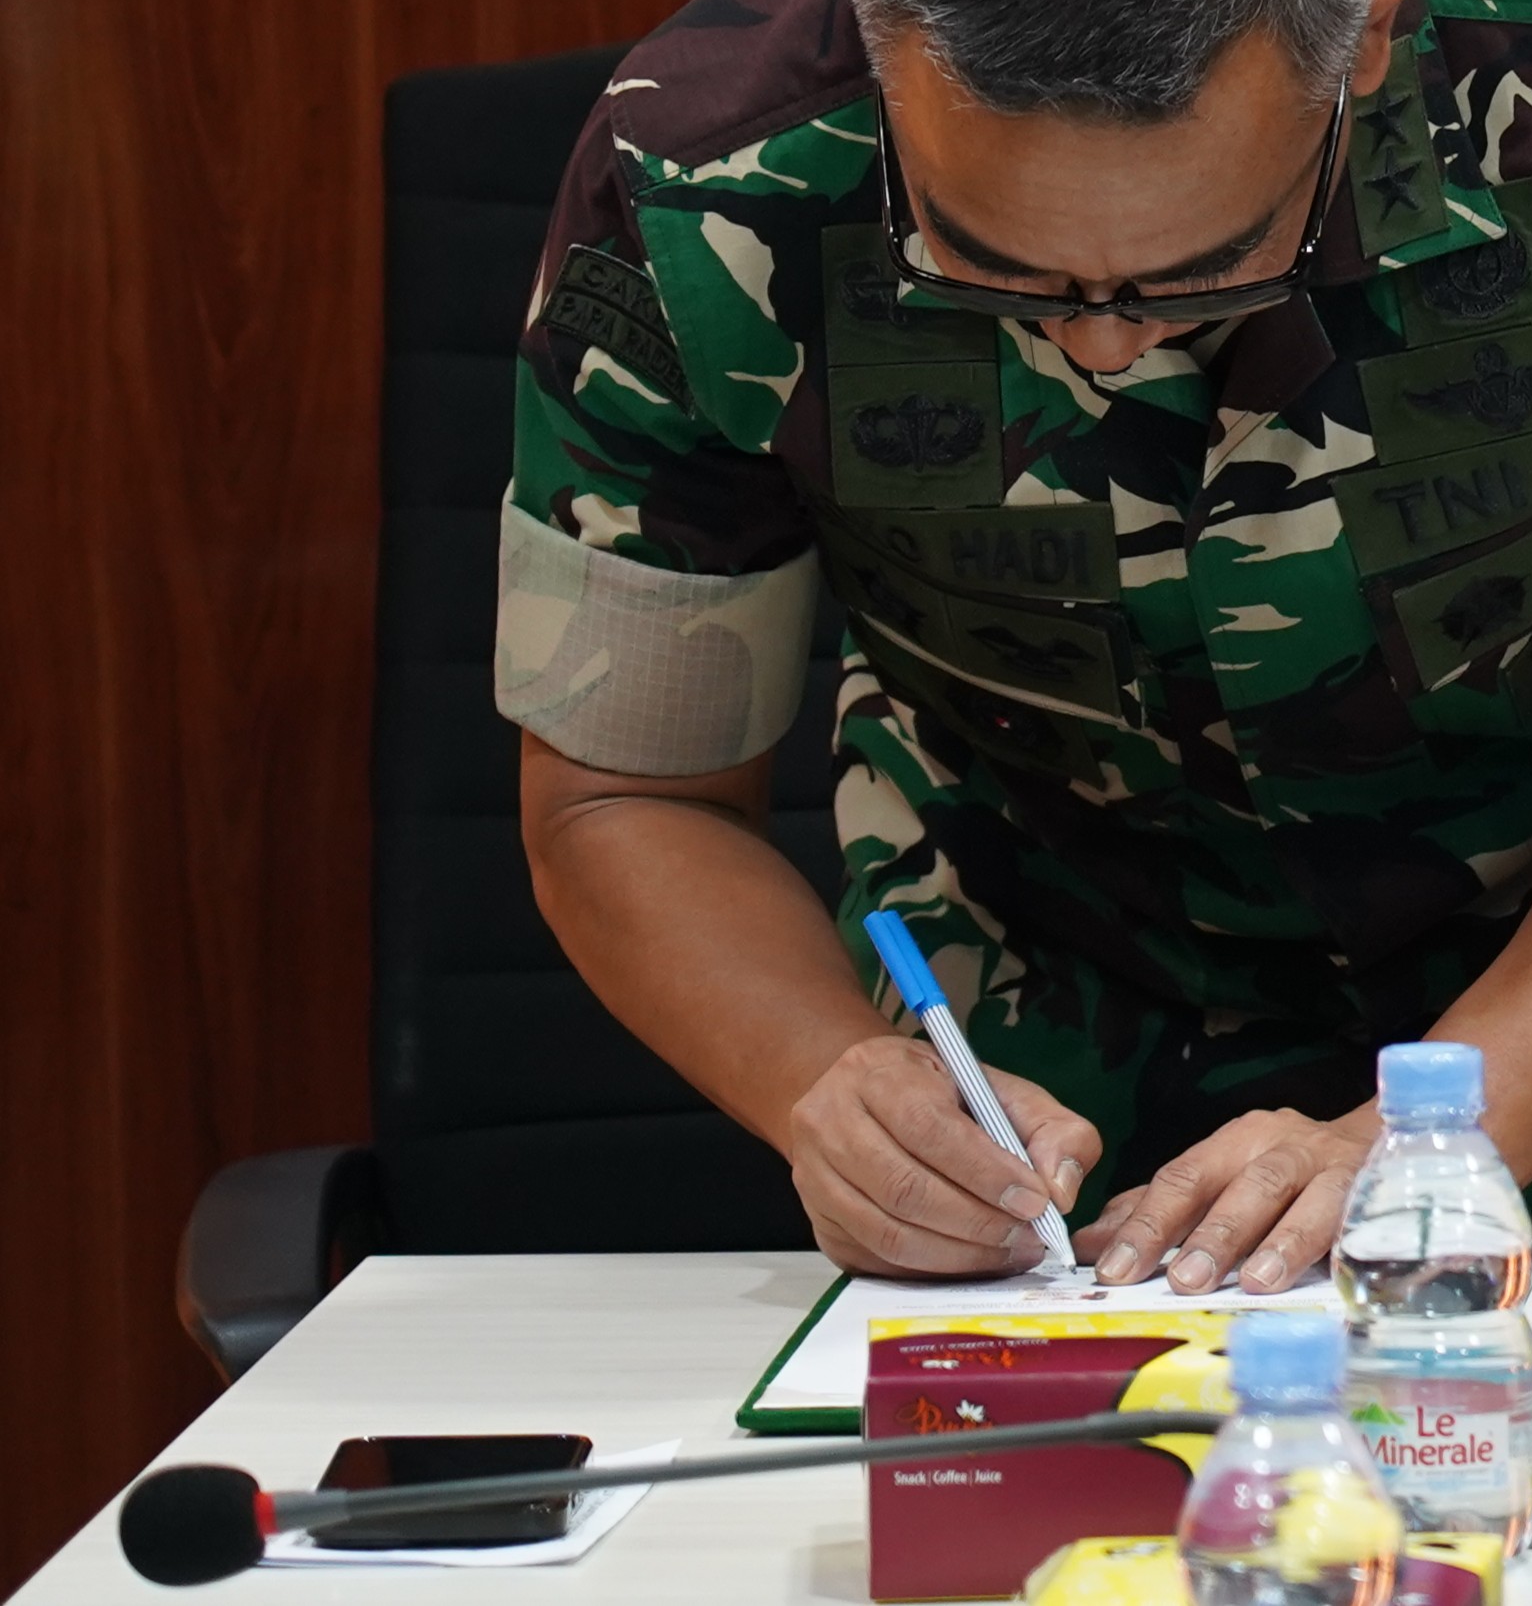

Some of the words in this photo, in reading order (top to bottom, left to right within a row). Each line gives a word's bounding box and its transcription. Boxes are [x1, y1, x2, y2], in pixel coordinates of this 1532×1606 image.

[1372, 459, 1529, 546] TNI
[948, 526, 1091, 586] HADI
[1416, 1404, 1457, 1438] Le
[1362, 1432, 1495, 1467] Minerale
[893, 1469, 927, 1486] Snack
[932, 1469, 968, 1485] Coffee
[974, 1468, 1002, 1484] Juice
